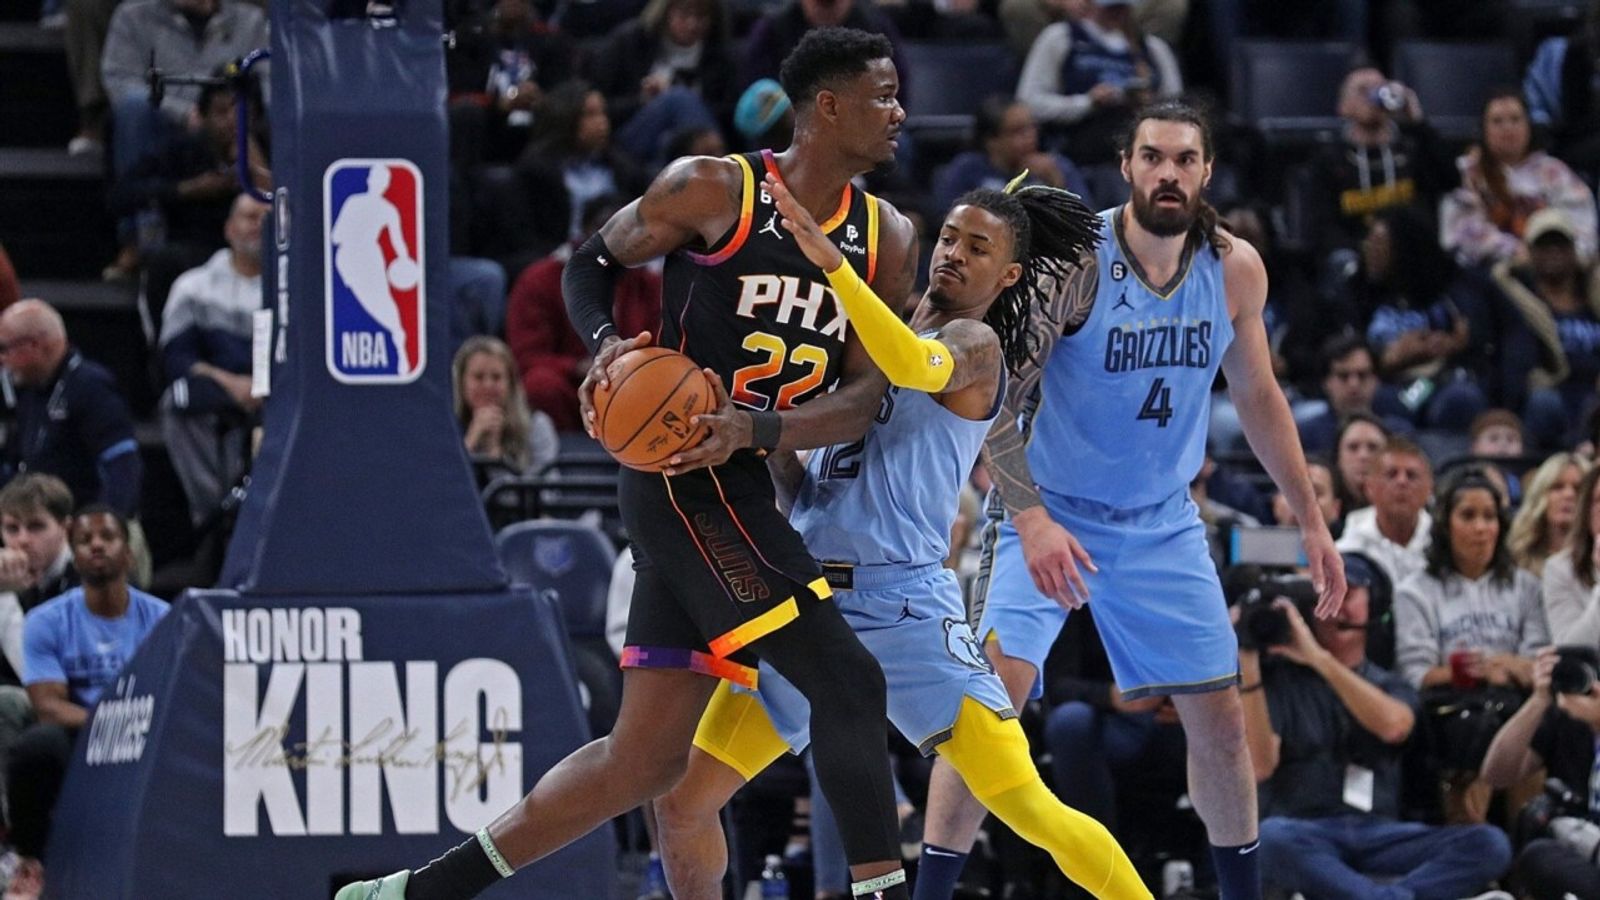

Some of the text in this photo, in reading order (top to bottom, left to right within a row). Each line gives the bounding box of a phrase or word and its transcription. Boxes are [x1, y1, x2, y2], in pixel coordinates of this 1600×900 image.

[840, 241, 867, 255] PayPal
[1112, 264, 1124, 280] 6
[736, 273, 849, 343] PHX
[341, 331, 389, 369] NBA
[730, 331, 829, 412] 22
[1104, 321, 1211, 373] GRIZZLIES
[1136, 377, 1173, 428] 4
[694, 512, 770, 603] SUNS
[222, 607, 364, 664] HONOR
[223, 657, 523, 837] KING
